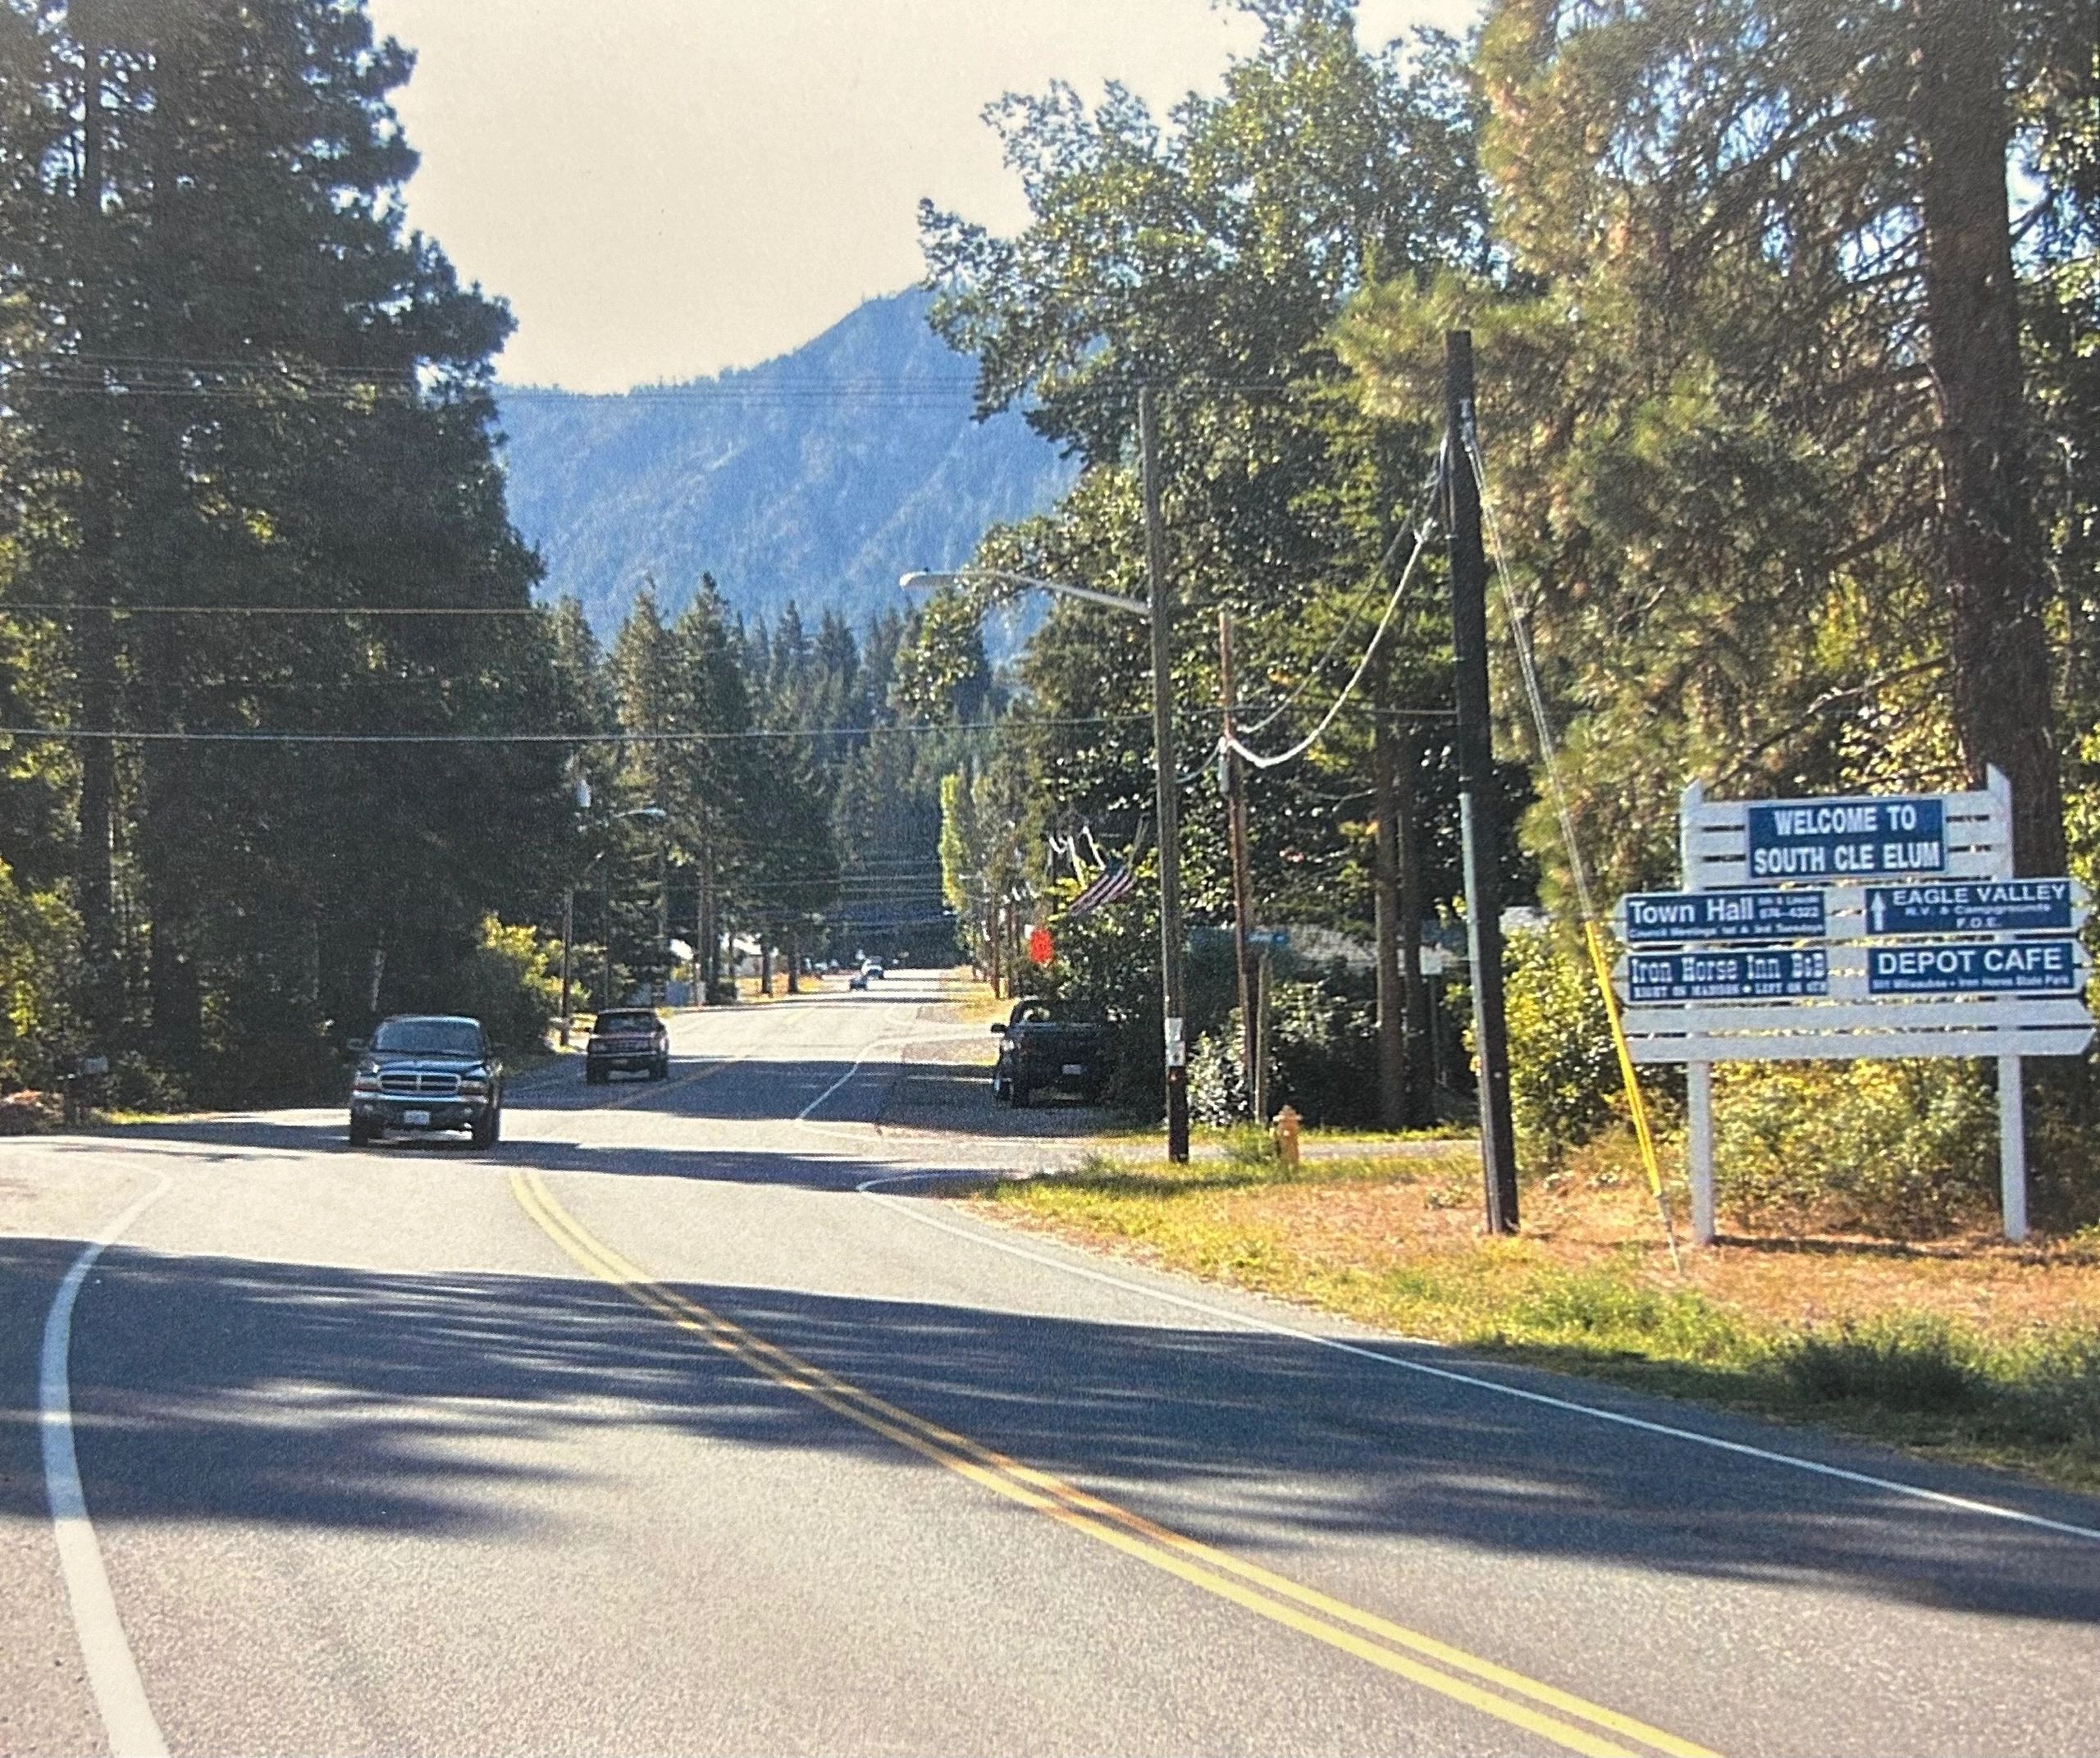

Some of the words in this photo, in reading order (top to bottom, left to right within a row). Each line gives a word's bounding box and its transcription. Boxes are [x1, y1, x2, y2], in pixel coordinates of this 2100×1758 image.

[1774, 806, 1878, 836] WELCOME
[1888, 805, 1917, 831] TO
[1754, 846, 1826, 874] SOUTH
[1834, 843, 1875, 871] CLE
[1883, 841, 1940, 869] ELUM
[1892, 887, 1969, 906] EAGLE
[1976, 884, 2066, 902] VALLEY
[1629, 901, 1696, 925] Town
[1706, 897, 1753, 920] Hall
[1631, 958, 1673, 984] Iron
[1682, 957, 1738, 982] Horse
[1746, 954, 1781, 979] Inn
[1879, 949, 1976, 975] DEPOT
[1984, 947, 2063, 972] CAFE
